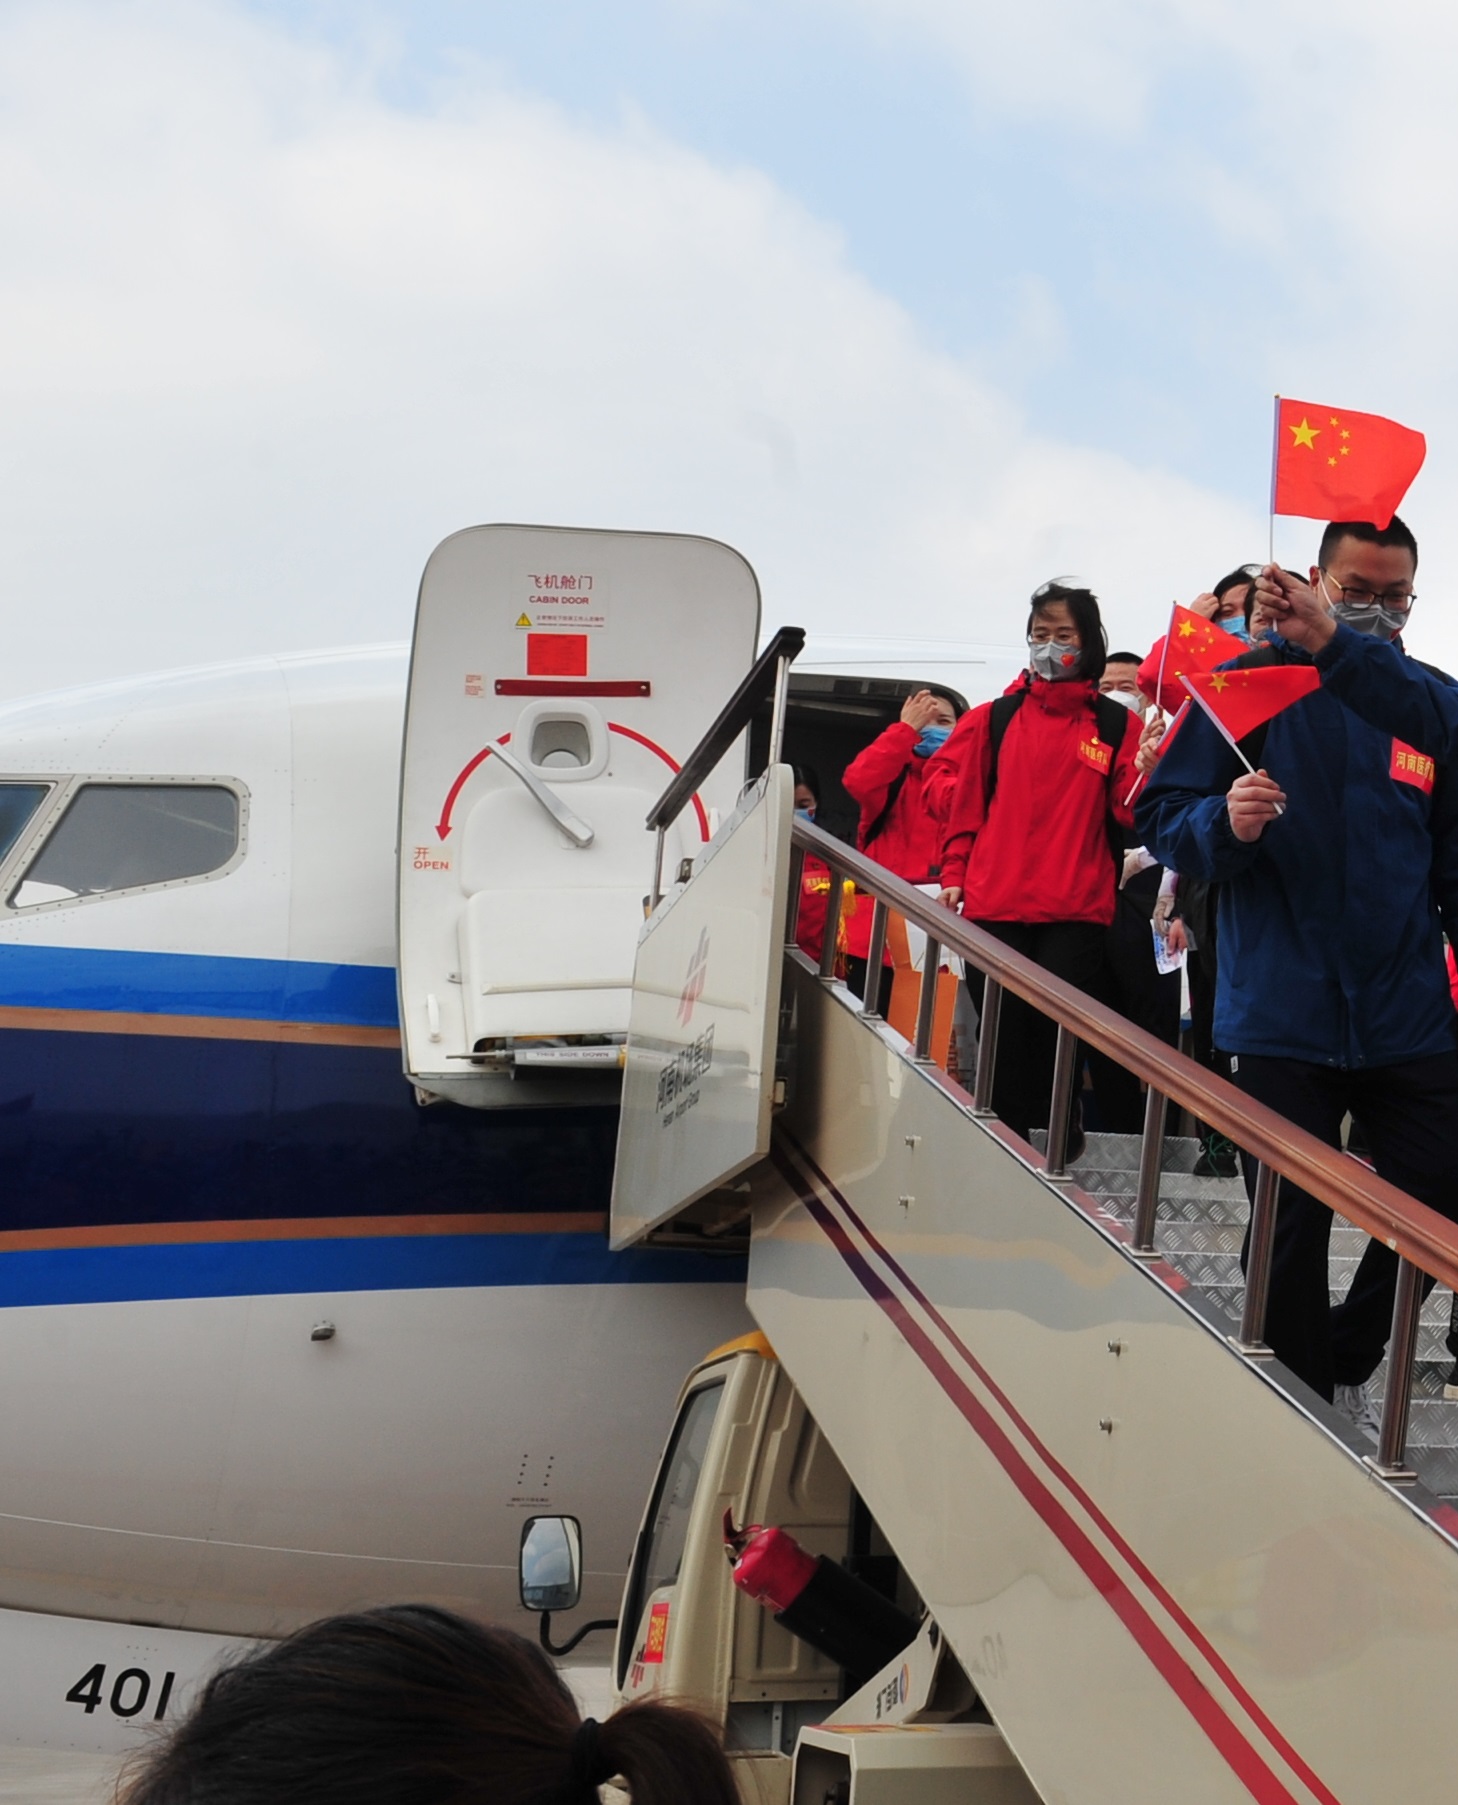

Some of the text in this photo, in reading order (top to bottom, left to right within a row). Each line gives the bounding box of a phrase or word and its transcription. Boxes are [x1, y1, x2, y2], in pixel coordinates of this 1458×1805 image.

[528, 574, 593, 590] 飞机舱门
[529, 595, 589, 605] CABIN DOOR
[414, 846, 430, 860] 开
[413, 861, 449, 871] OPEN
[65, 1662, 174, 1721] 401
